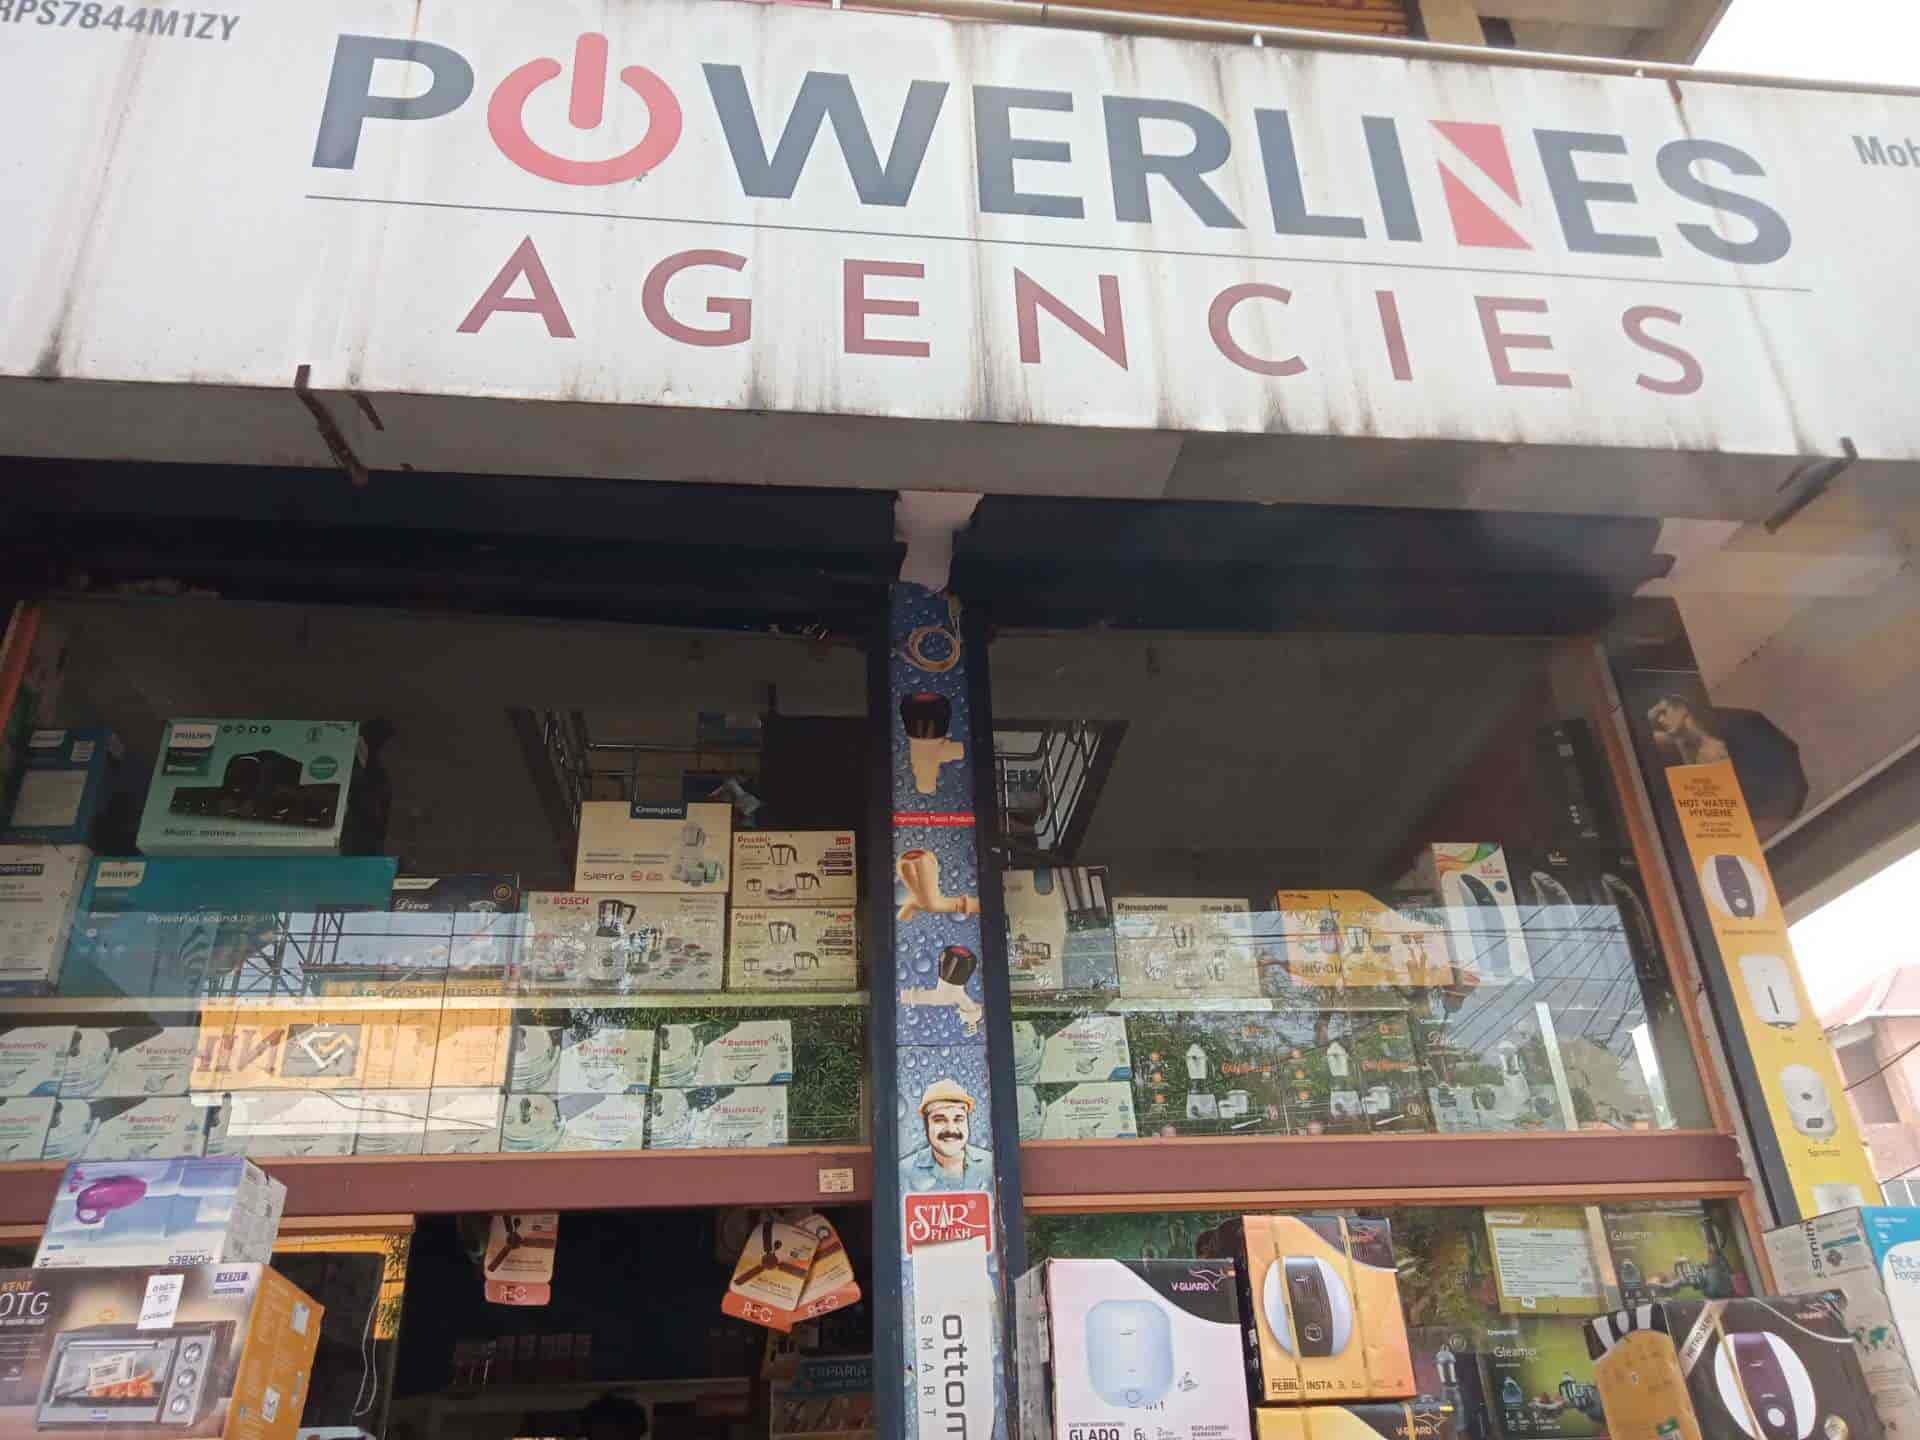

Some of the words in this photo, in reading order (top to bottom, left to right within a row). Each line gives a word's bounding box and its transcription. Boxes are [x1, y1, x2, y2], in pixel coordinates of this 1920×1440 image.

[311, 31, 1792, 265] POWERLINES
[456, 235, 1704, 395] AGENCIES
[635, 805, 683, 815] Crompton
[553, 896, 590, 905] BOSCH
[1117, 903, 1168, 912] Panasonic
[909, 1200, 987, 1241] STAR
[0, 1292, 49, 1316] OTG
[1306, 1380, 1333, 1391] INSTA
